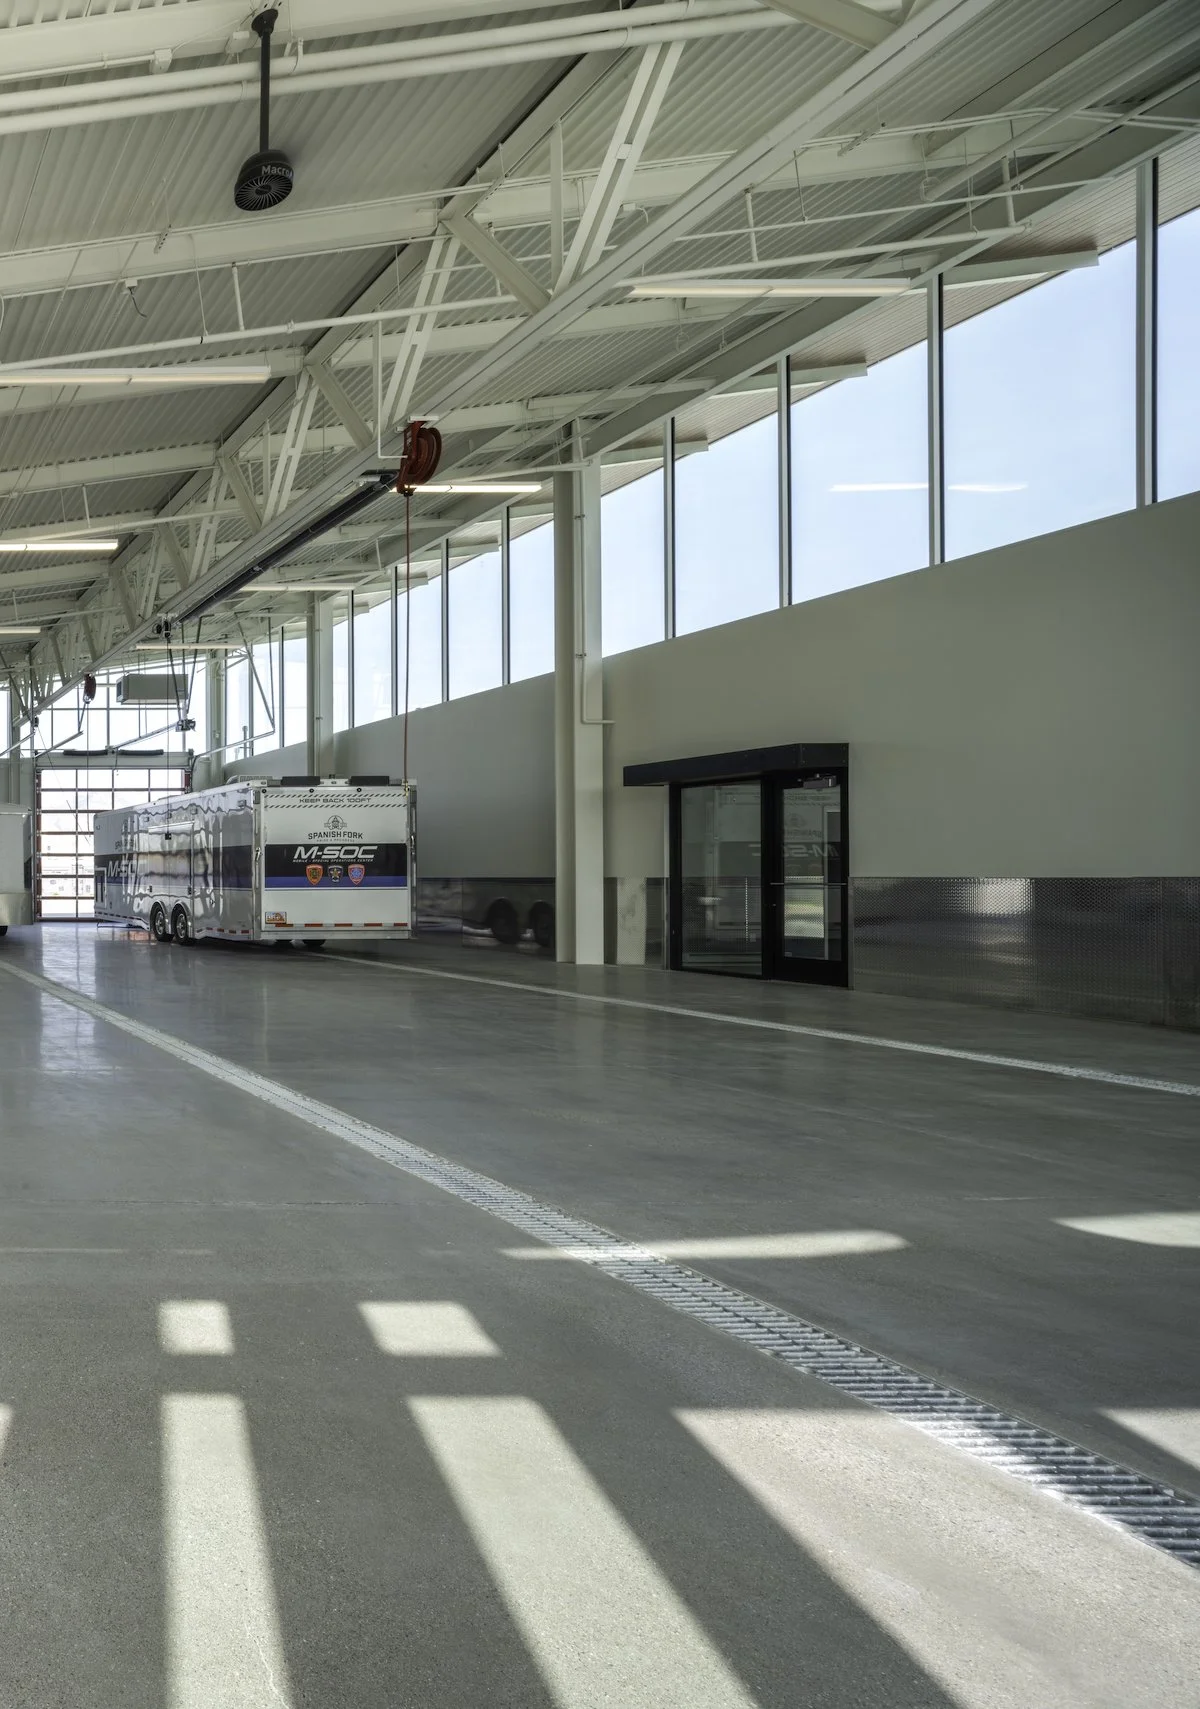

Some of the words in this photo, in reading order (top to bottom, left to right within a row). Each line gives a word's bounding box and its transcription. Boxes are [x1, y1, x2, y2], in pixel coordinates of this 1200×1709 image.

[308, 831, 341, 840] SPANISH
[342, 831, 364, 840] FORK
[293, 845, 378, 859] M-SOC
